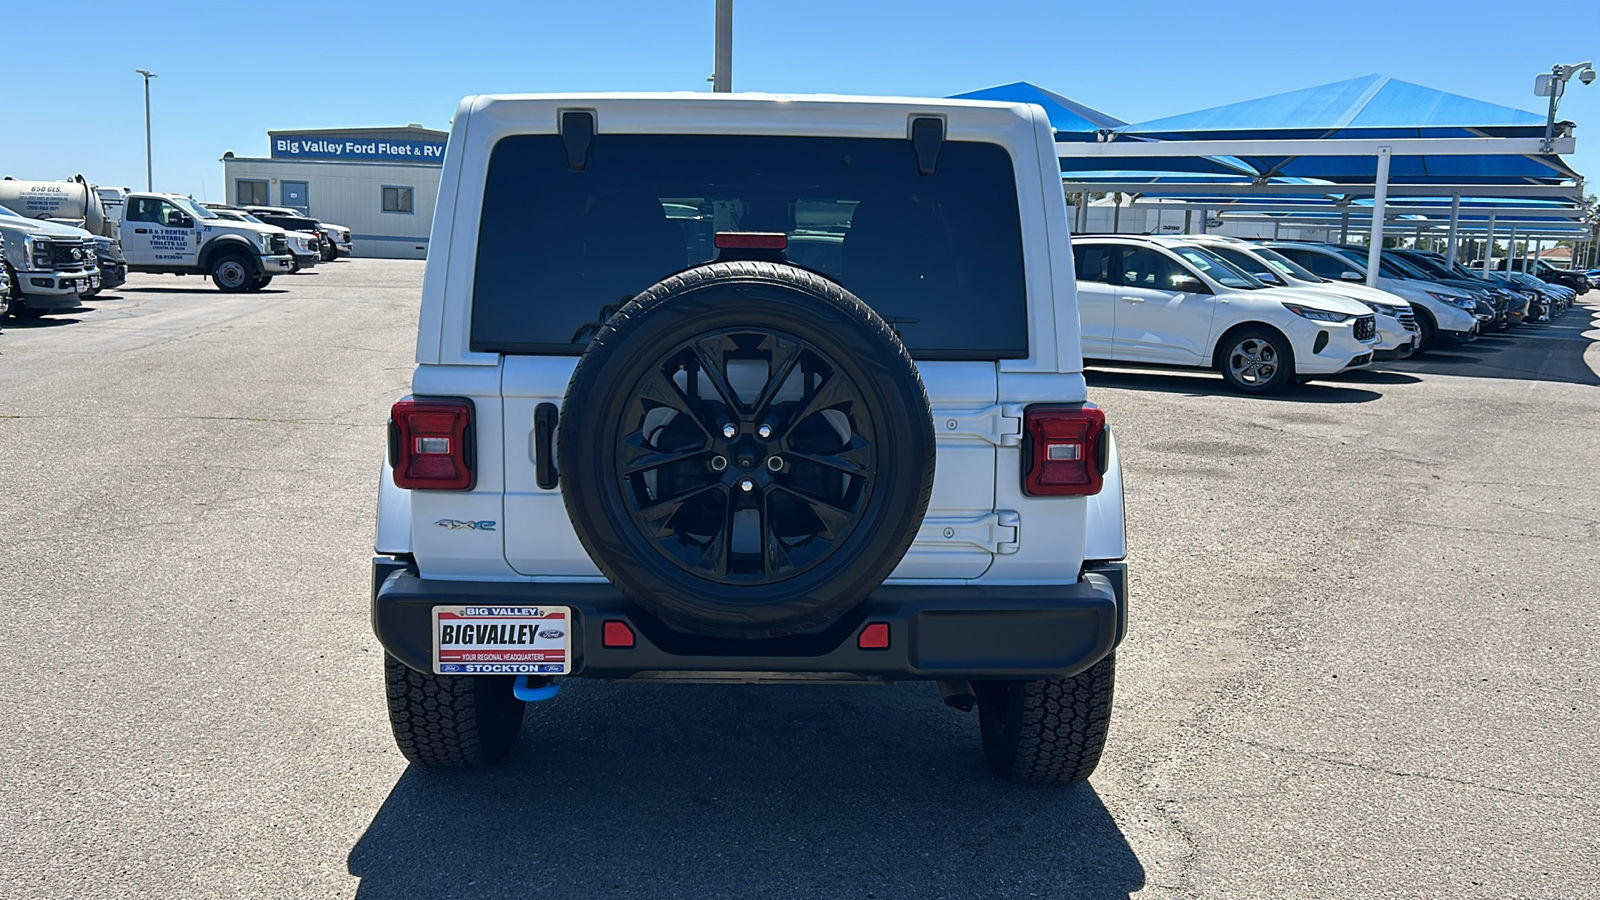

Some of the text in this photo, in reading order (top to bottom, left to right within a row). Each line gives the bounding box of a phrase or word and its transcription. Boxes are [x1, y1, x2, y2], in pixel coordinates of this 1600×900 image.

[277, 140, 443, 157] Big Valley Ford Fleet & RV
[441, 624, 540, 645] BIGVALLEY
